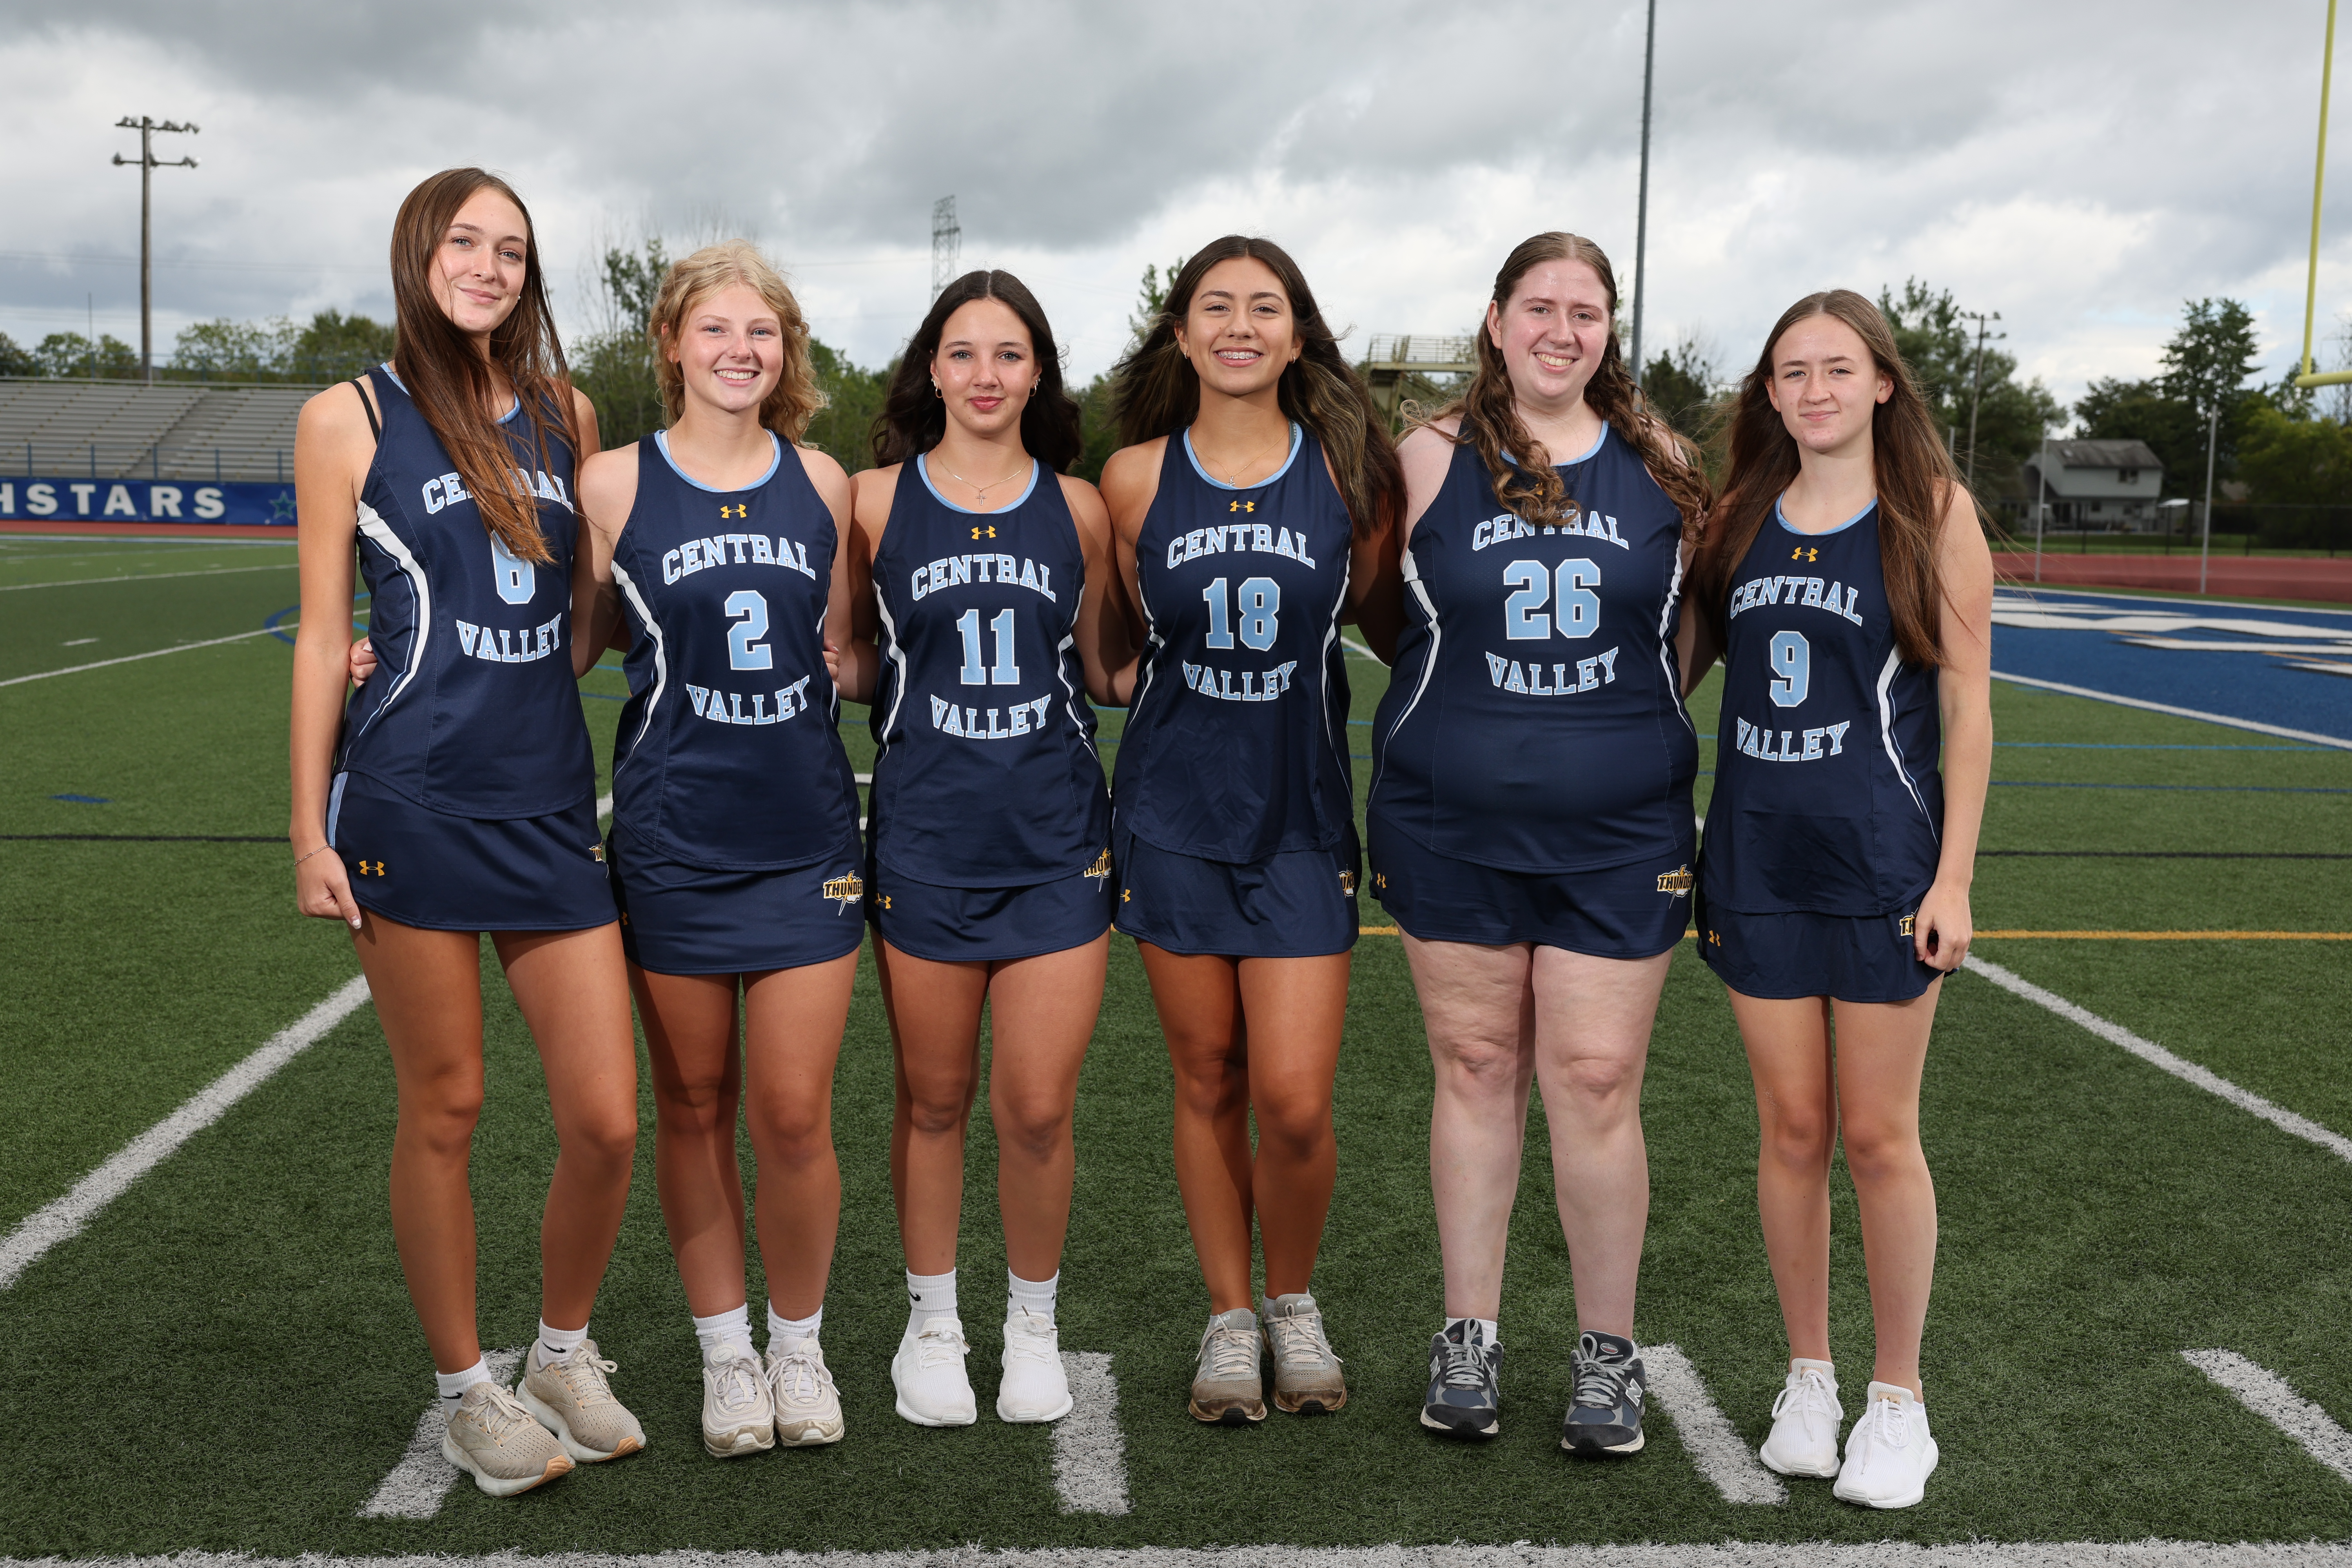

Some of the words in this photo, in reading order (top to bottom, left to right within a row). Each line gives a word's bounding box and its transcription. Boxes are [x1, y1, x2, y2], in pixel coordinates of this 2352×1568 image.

[490, 529, 535, 604] 6
[662, 534, 815, 585] CENTRAL
[1167, 524, 1315, 570] CENTRAL
[912, 554, 1056, 603] CENTRAL
[1503, 558, 1601, 640] 26
[1730, 575, 1863, 626] CENTRAL
[456, 612, 562, 663] VALLEY
[724, 590, 773, 670] 2
[1203, 577, 1280, 652] 18
[956, 608, 1020, 685] 11
[1486, 646, 1618, 696] VALLEY
[1769, 630, 1810, 707] 9
[686, 675, 810, 725] VALLEY
[1182, 659, 1297, 701] VALLEY
[930, 693, 1051, 739] VALLEY
[1737, 716, 1850, 762] VALLEY
[825, 881, 862, 896] THUNDER
[1659, 876, 1692, 889] THUNDER
